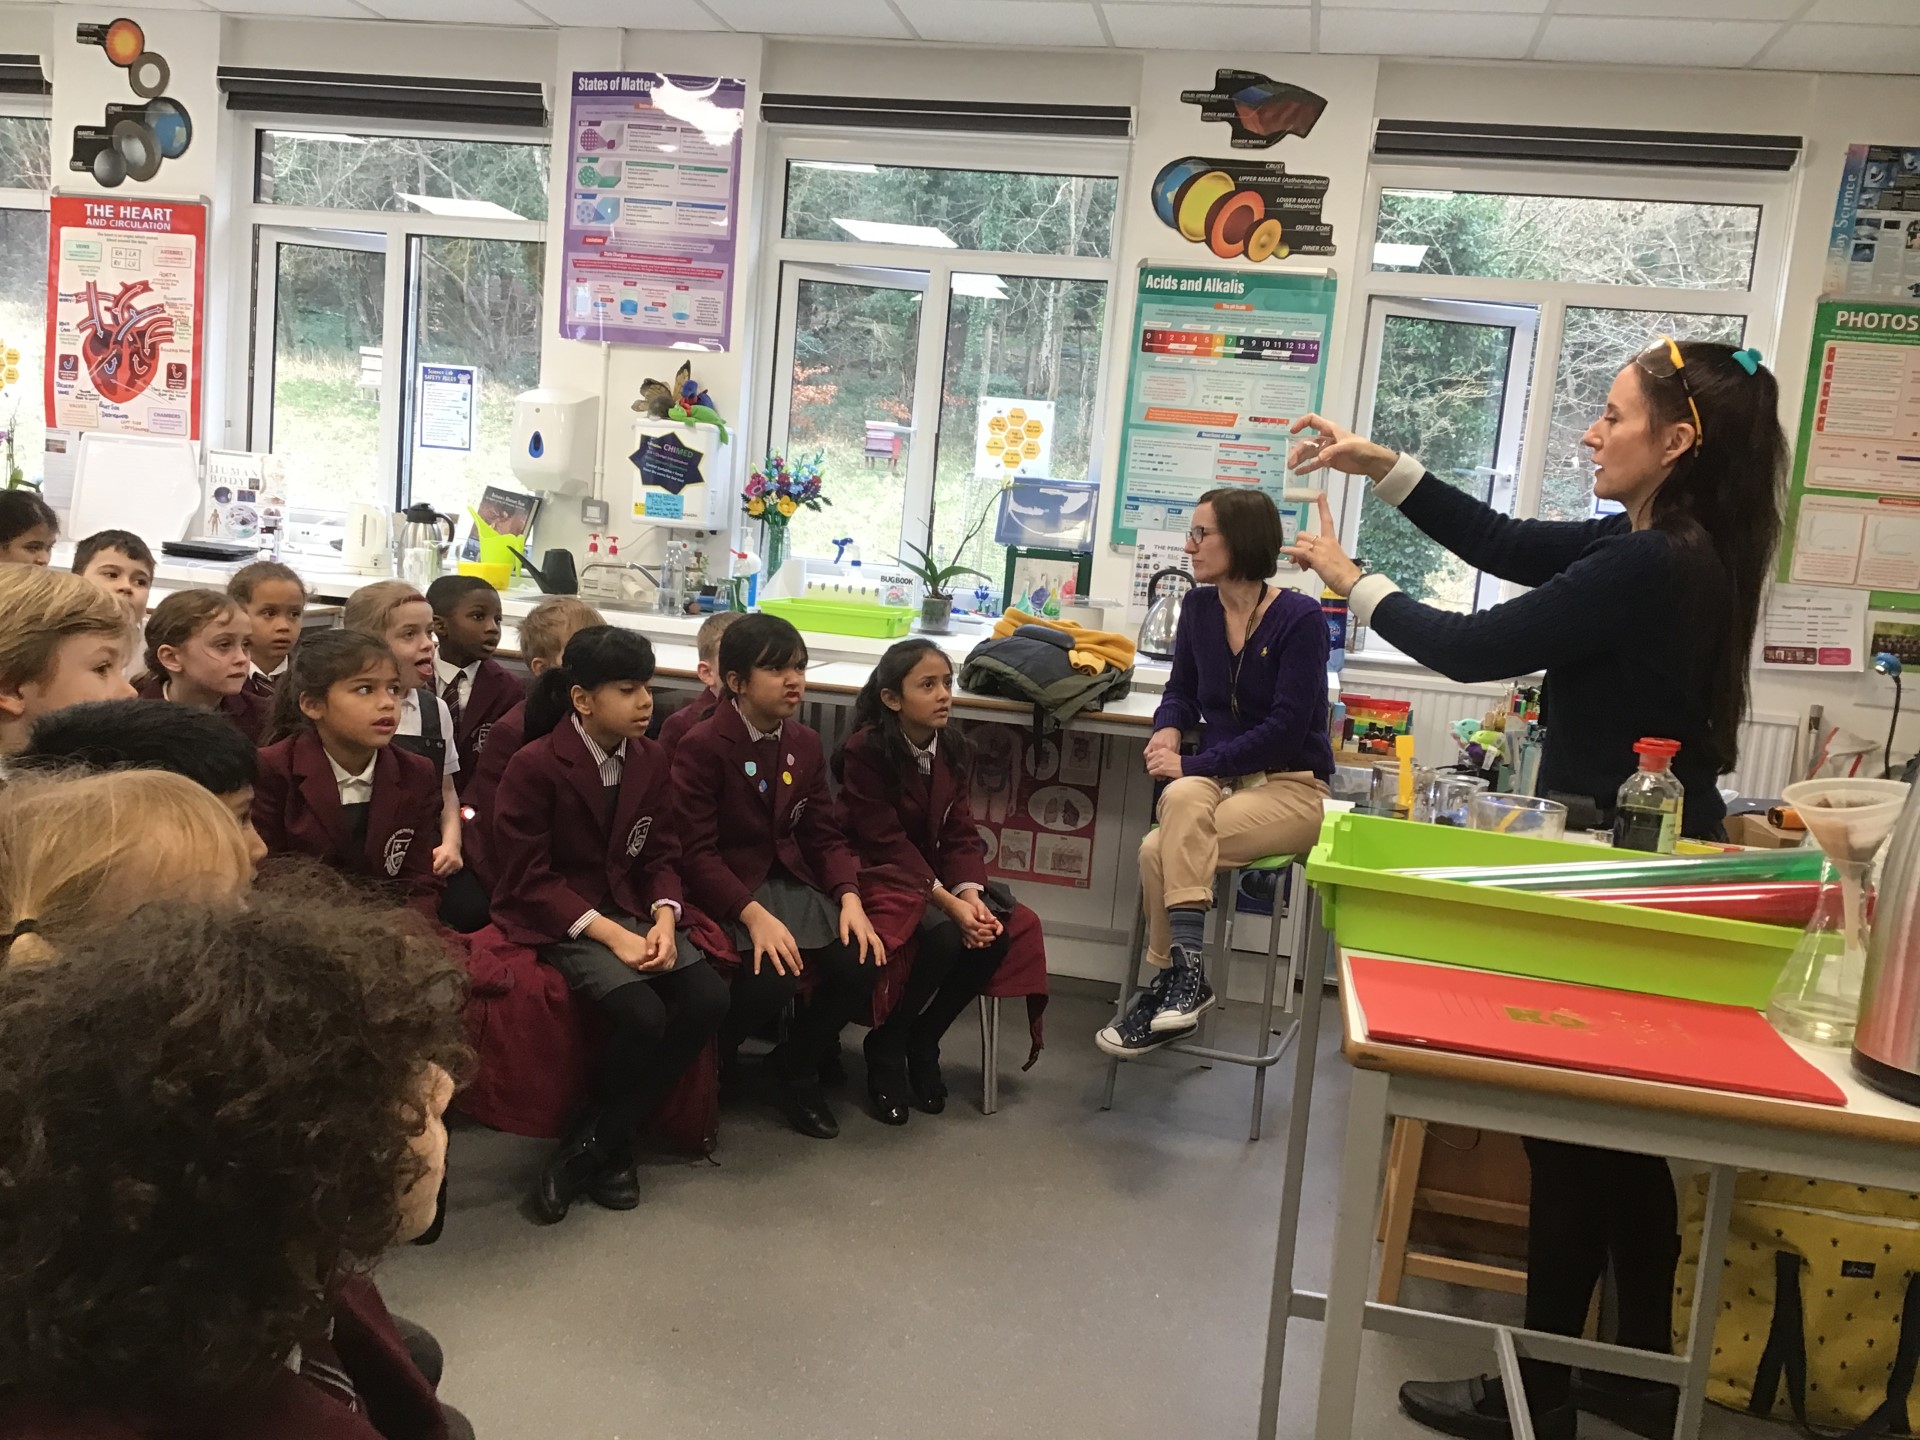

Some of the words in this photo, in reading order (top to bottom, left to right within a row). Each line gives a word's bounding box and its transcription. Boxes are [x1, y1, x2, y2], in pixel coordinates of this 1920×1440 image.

[578, 77, 608, 91] States
[610, 77, 620, 91] of
[621, 77, 655, 91] Matter
[1834, 174, 1856, 228] Science
[84, 204, 114, 218] THE
[120, 206, 173, 221] HEART
[86, 218, 106, 226] AND
[109, 220, 171, 230] CIRCULATION
[1146, 275, 1178, 290] Acids
[1180, 277, 1202, 292] and
[1204, 278, 1245, 294] Alkalis
[1836, 311, 1919, 331] PHOTOS
[664, 444, 693, 458] CHIMED
[210, 465, 257, 477] HUMAN
[211, 475, 243, 486] BODY
[880, 575, 895, 583] BUG
[896, 577, 913, 585] BOOK
